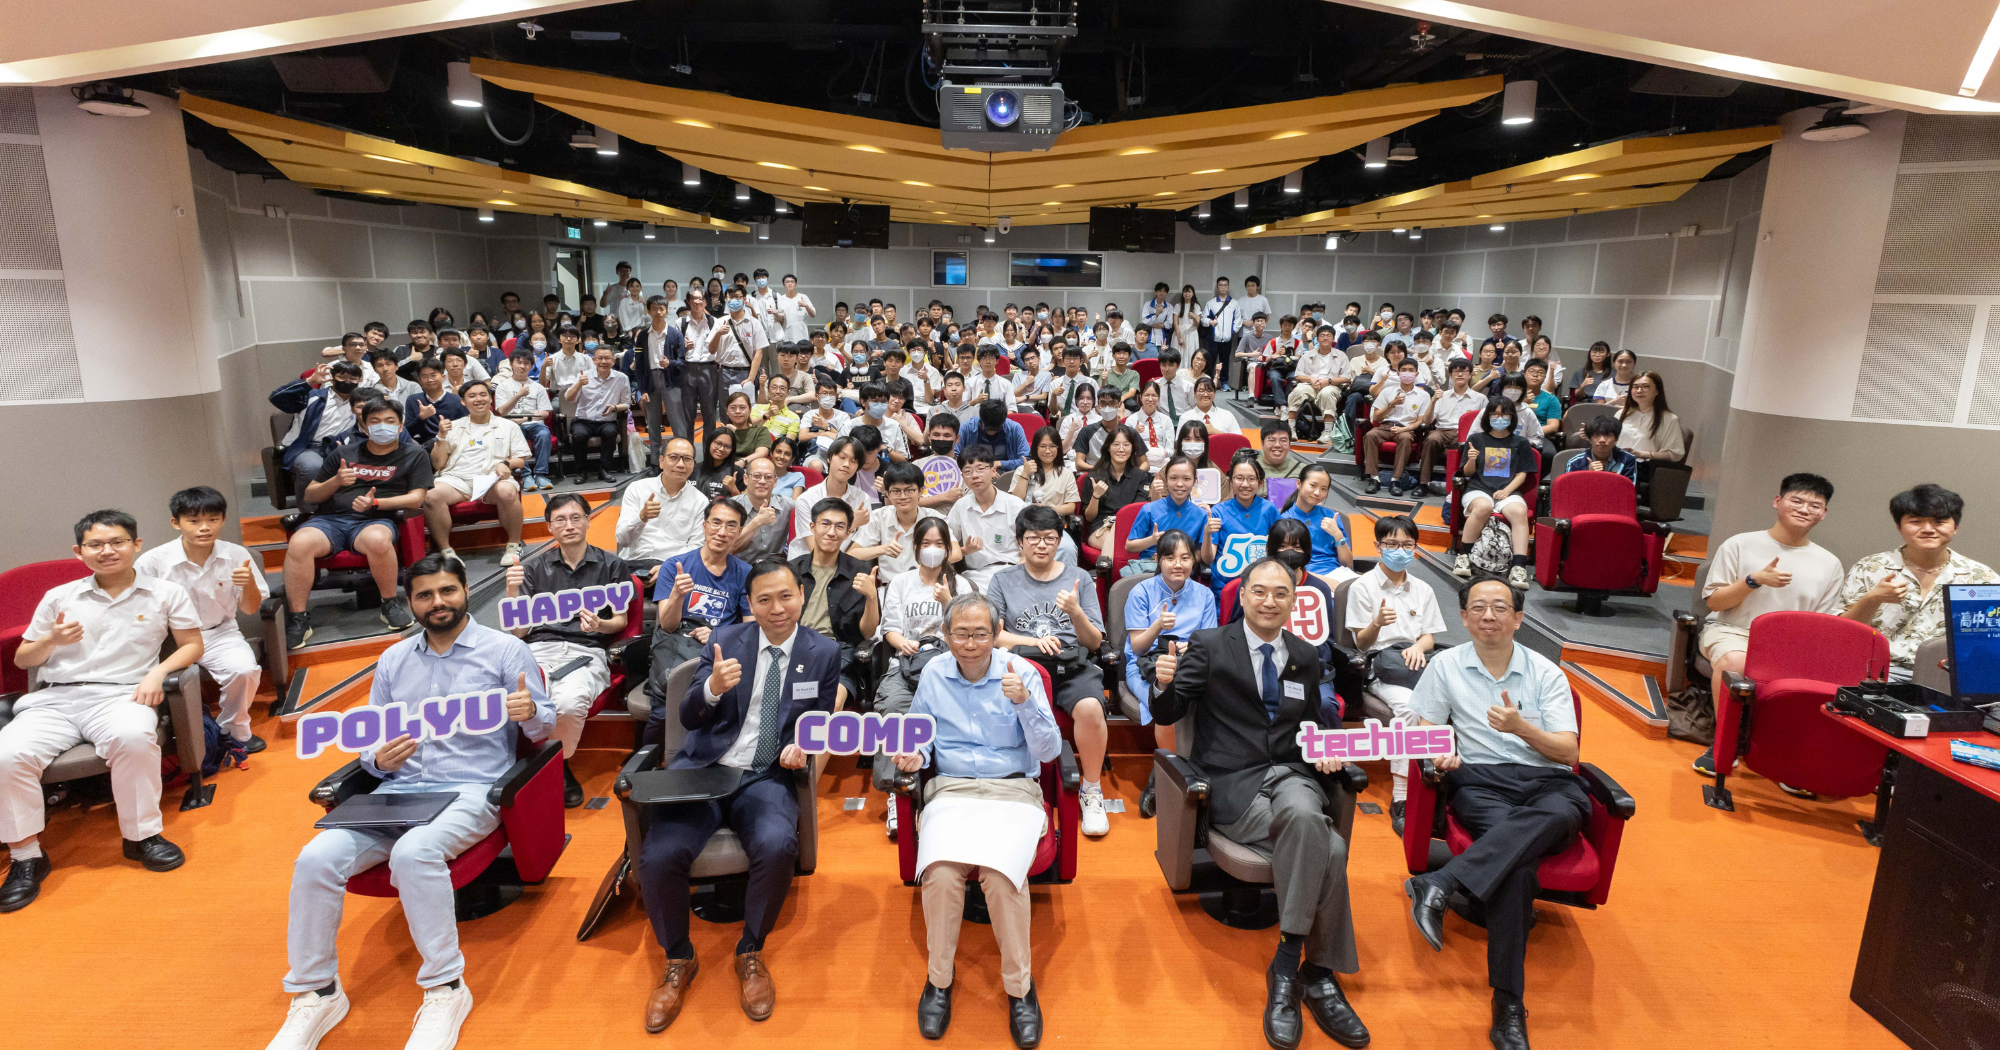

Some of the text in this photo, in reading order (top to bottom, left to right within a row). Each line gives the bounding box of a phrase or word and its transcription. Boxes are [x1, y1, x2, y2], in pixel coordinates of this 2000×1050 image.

[501, 584, 631, 628] HAPPY
[302, 693, 502, 756] POLYU
[798, 715, 933, 753] COMP
[1300, 721, 1452, 759] techies
